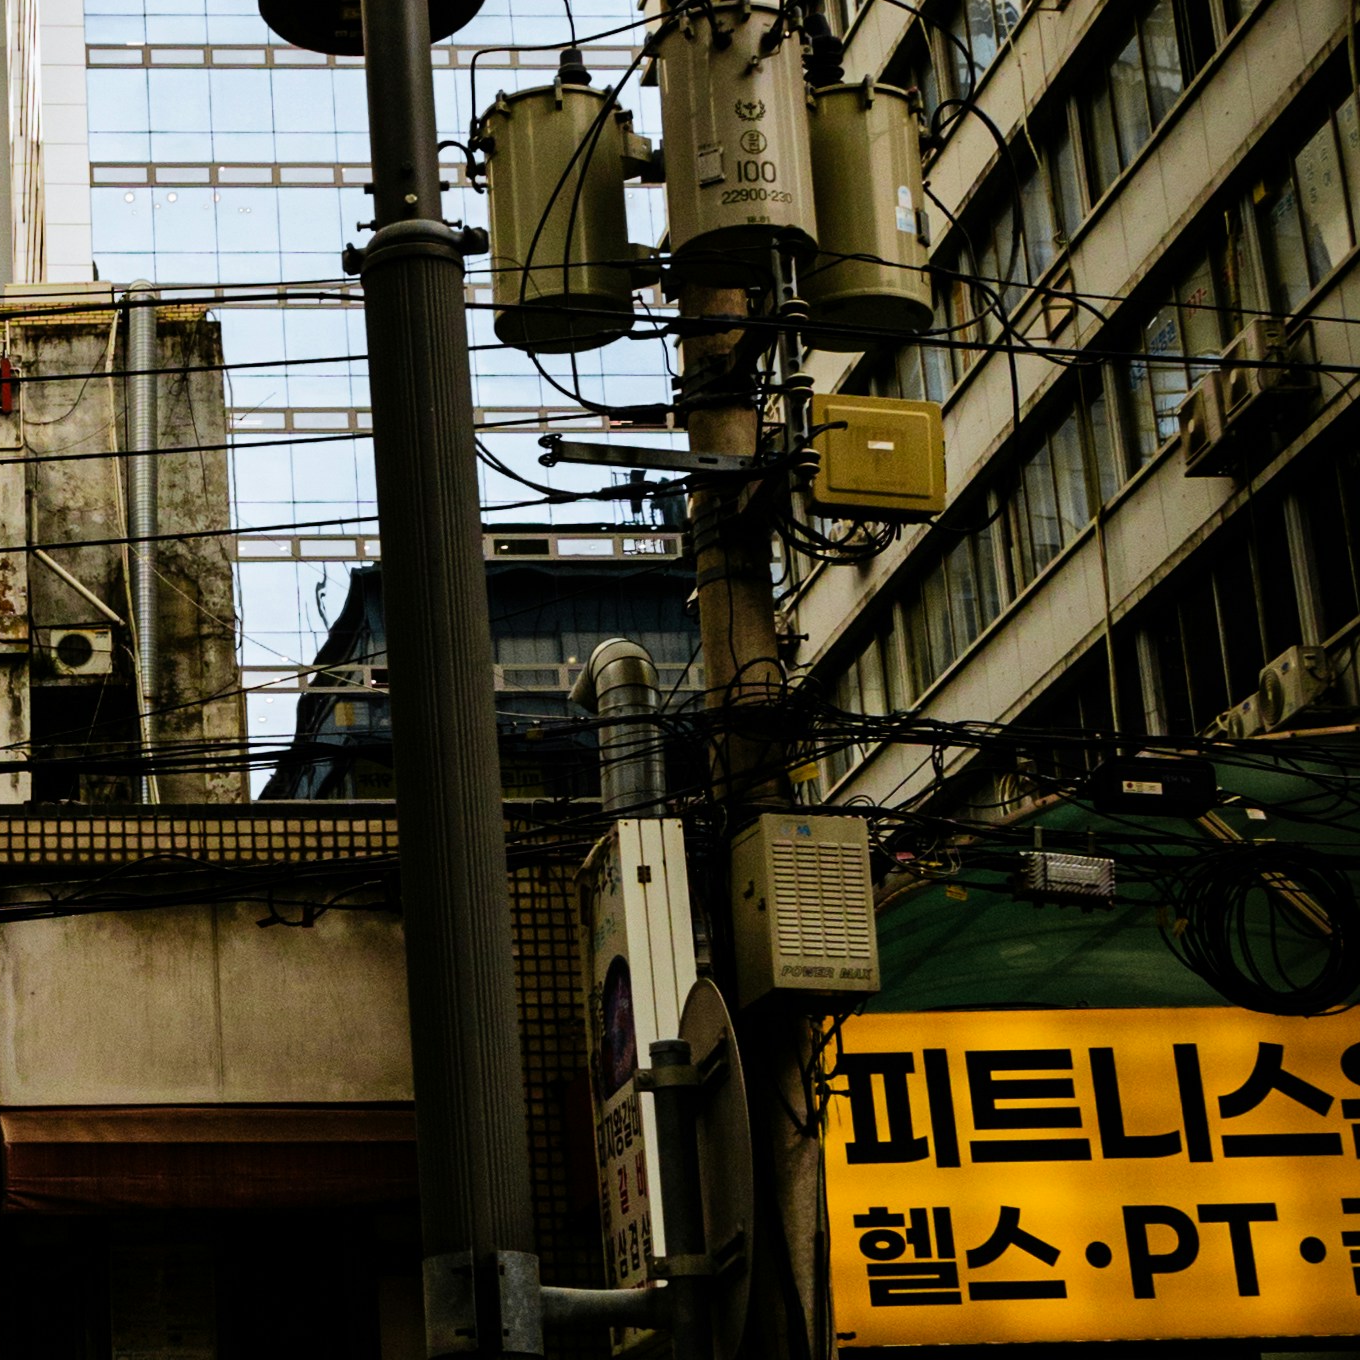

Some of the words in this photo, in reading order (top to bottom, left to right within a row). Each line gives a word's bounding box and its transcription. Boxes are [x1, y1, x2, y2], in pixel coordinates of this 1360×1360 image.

[737, 160, 776, 183] 100
[781, 965, 835, 980] POWER
[839, 967, 873, 981] MAX
